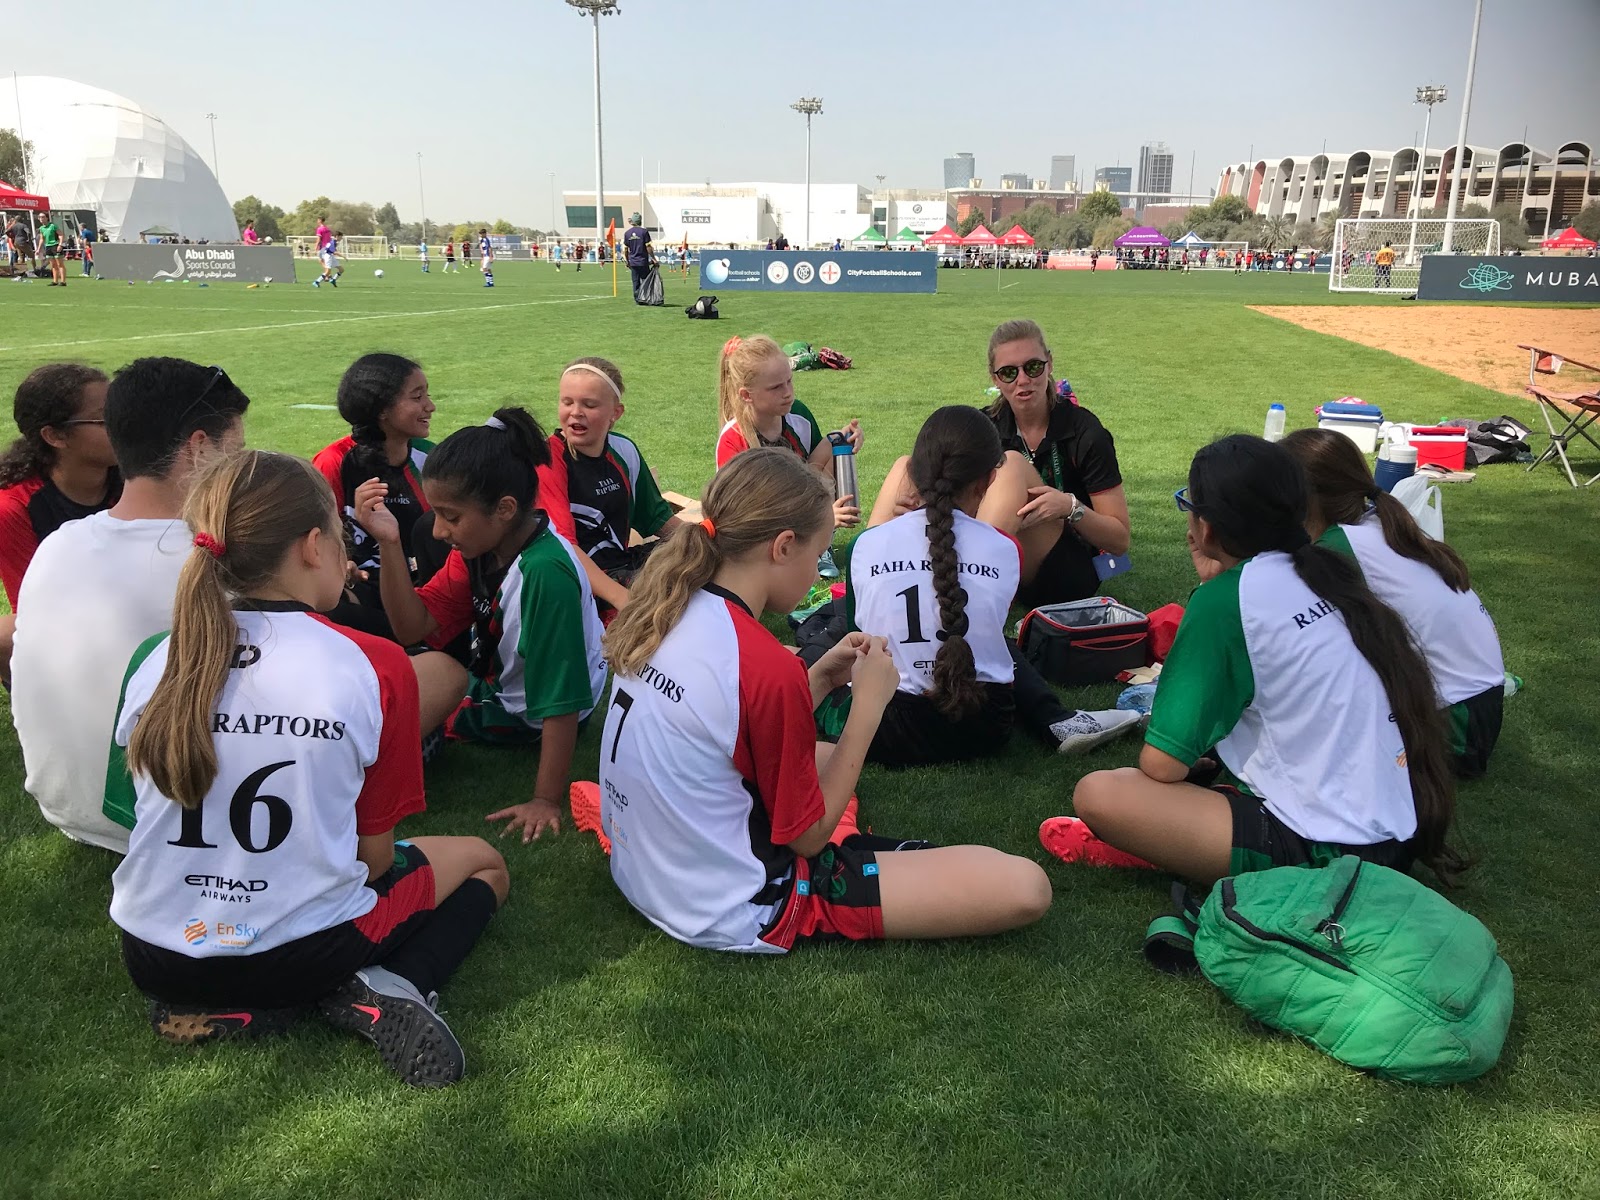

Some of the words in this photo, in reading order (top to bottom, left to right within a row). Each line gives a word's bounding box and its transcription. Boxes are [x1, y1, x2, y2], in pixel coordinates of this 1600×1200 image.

[185, 249, 205, 260] Abu
[206, 249, 235, 260] Dhabi
[185, 260, 209, 270] Sports
[210, 260, 236, 270] Council
[847, 269, 922, 277] CityFootballSchools.com
[870, 560, 916, 577] RAHA
[920, 560, 1000, 579] RTORS
[637, 662, 686, 703] PTORS
[213, 713, 346, 741] RAPTORS
[610, 686, 635, 765] 7
[166, 759, 297, 854] 16
[184, 874, 269, 892] ETIHAD
[200, 889, 252, 904] AIRWAYS
[216, 922, 261, 940] EnSky
